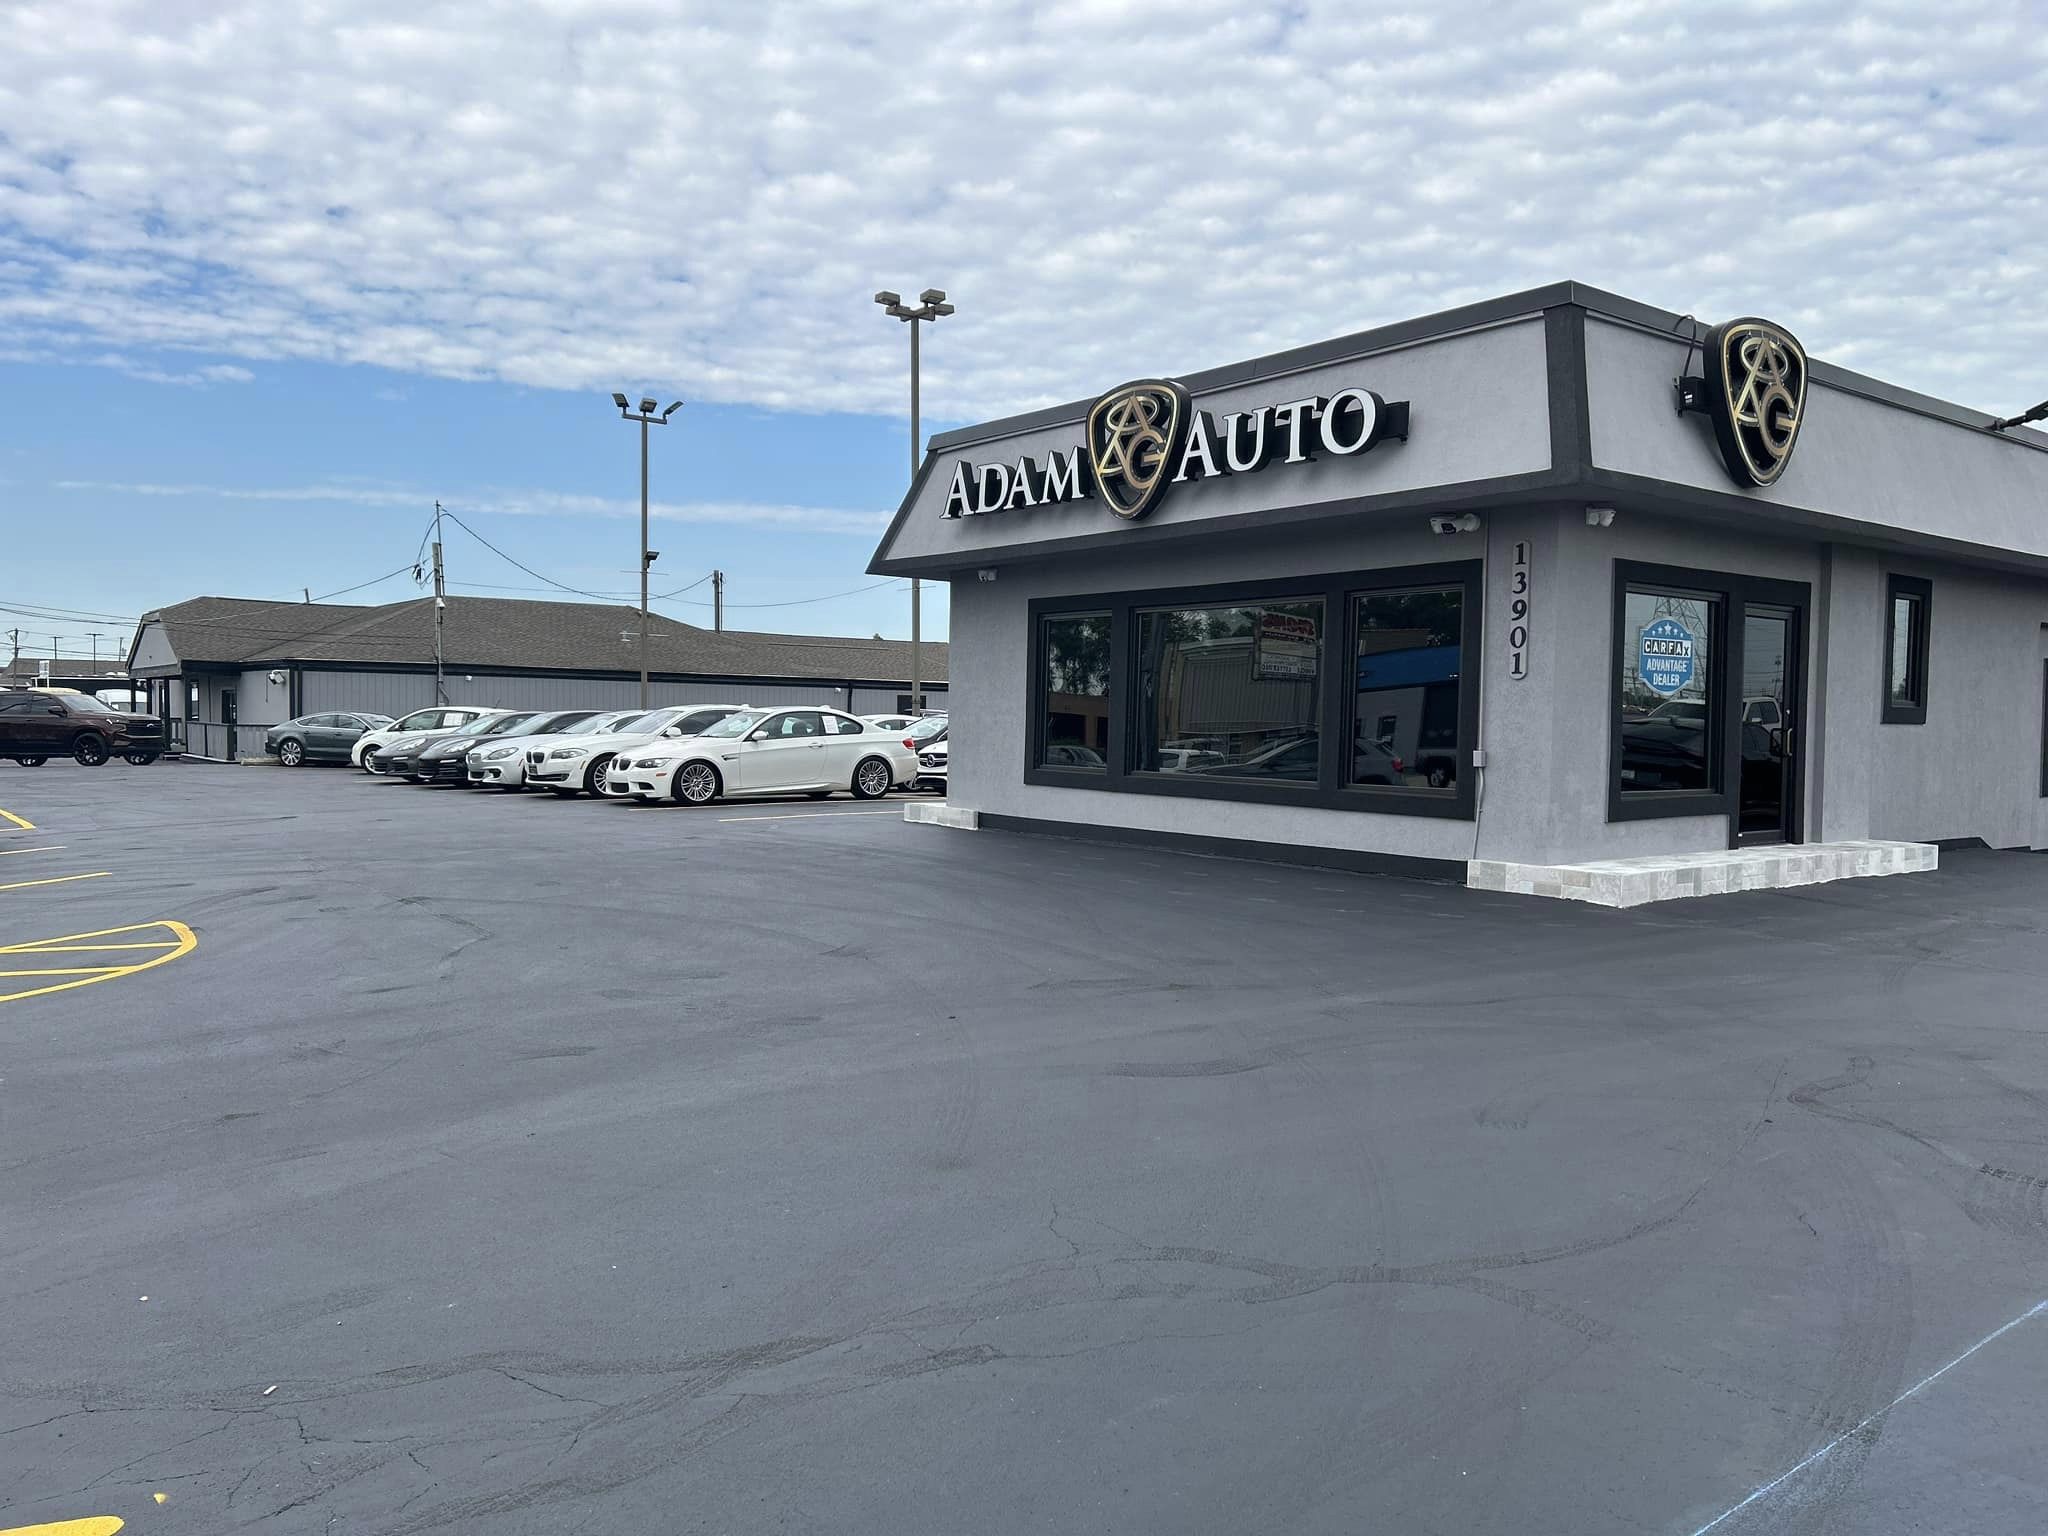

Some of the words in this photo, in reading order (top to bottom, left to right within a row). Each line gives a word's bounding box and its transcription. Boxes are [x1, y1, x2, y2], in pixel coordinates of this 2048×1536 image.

[940, 446, 1086, 519] ADAM
[1171, 388, 1377, 482] AUTO
[1509, 542, 1527, 675] 13901
[1644, 640, 1690, 657] CARFAX
[1646, 658, 1688, 673] ADVANTAGE
[1653, 673, 1680, 686] DEALER
